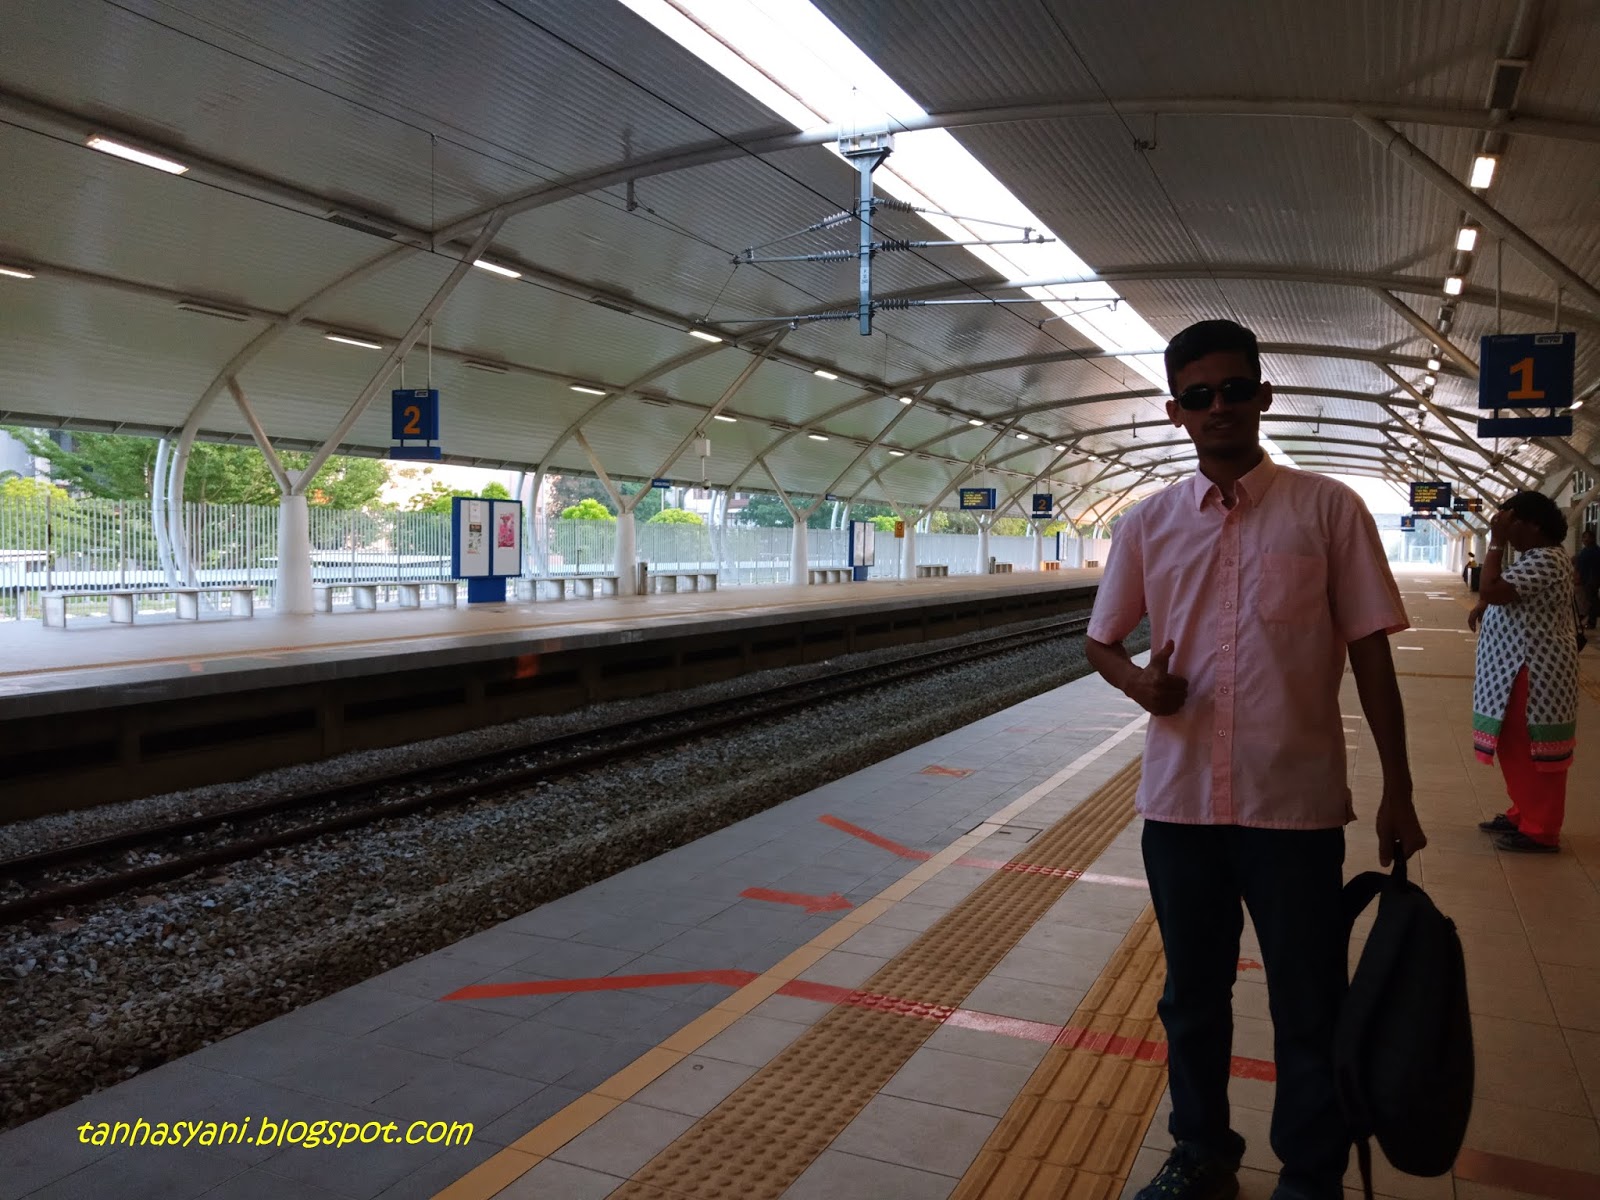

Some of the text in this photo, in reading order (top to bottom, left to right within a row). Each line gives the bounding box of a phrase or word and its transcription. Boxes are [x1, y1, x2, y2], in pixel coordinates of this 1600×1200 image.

[1507, 357, 1546, 400] 1
[403, 405, 421, 435] 2
[1038, 499, 1047, 510] 2
